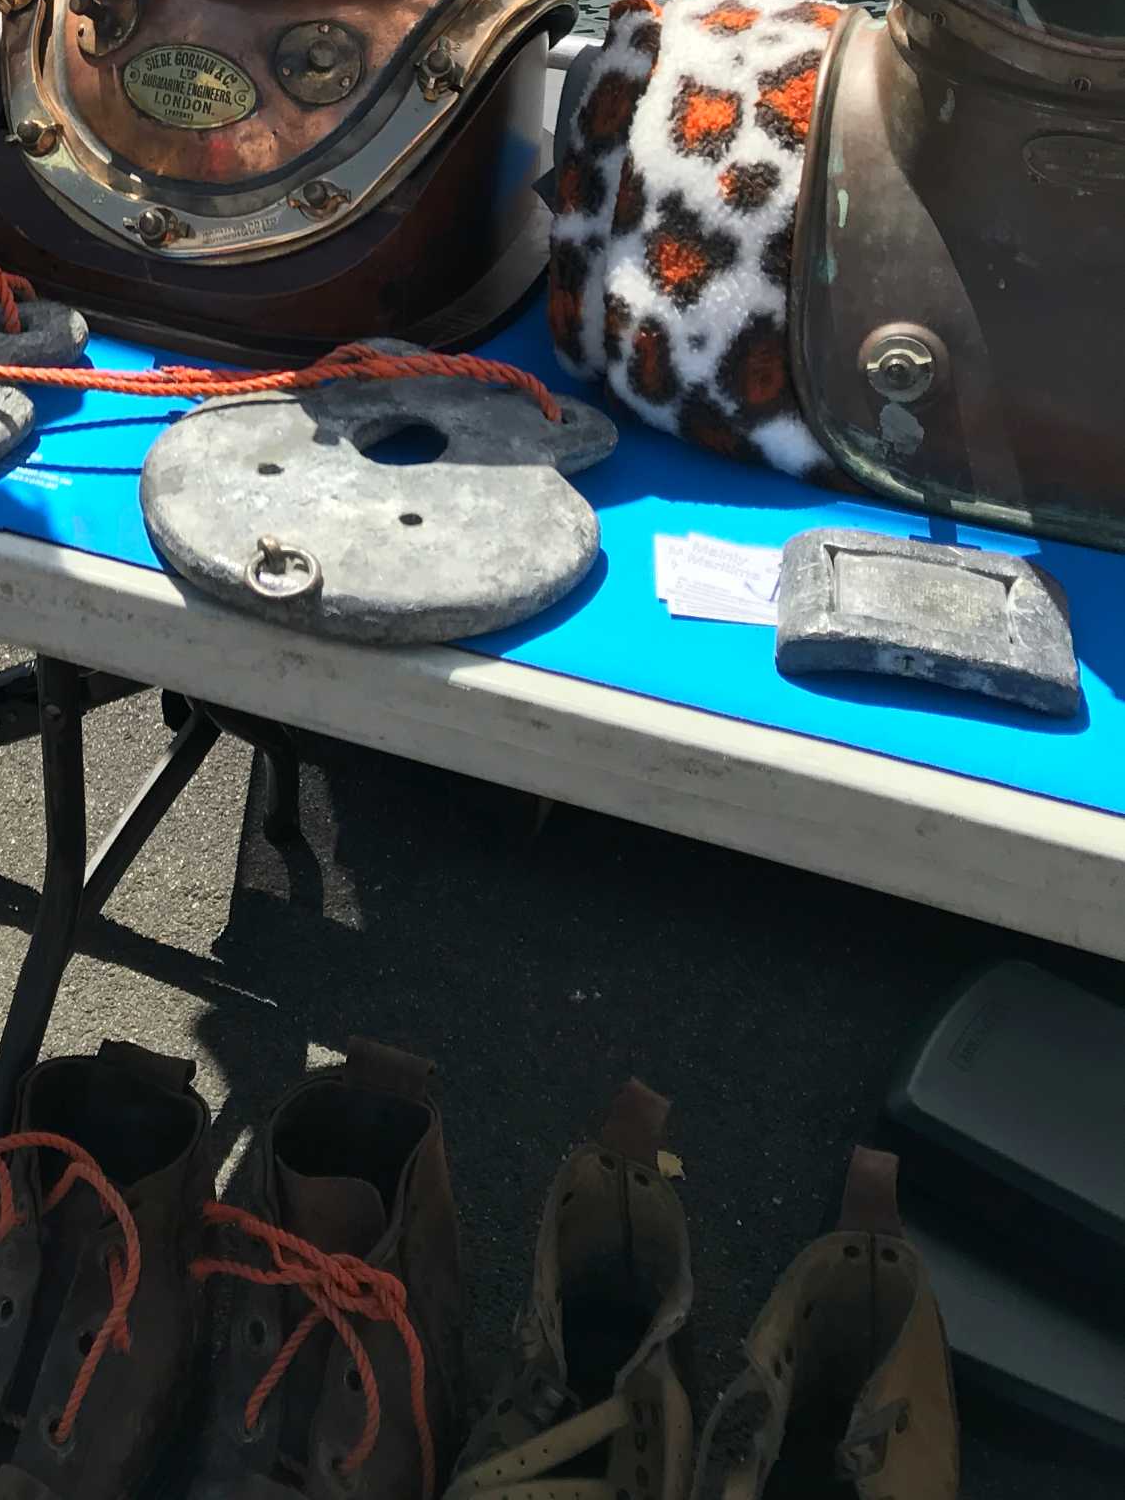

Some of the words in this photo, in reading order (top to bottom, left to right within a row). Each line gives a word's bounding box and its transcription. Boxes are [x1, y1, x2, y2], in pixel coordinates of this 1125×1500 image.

[145, 52, 172, 72] SIEBE
[175, 51, 217, 76] GORMAN
[214, 66, 226, 82] &
[141, 73, 186, 95] SUBMARINE
[186, 82, 233, 106] ENGINEERS,
[154, 92, 215, 117] LONDON.
[691, 541, 749, 568] Mainly
